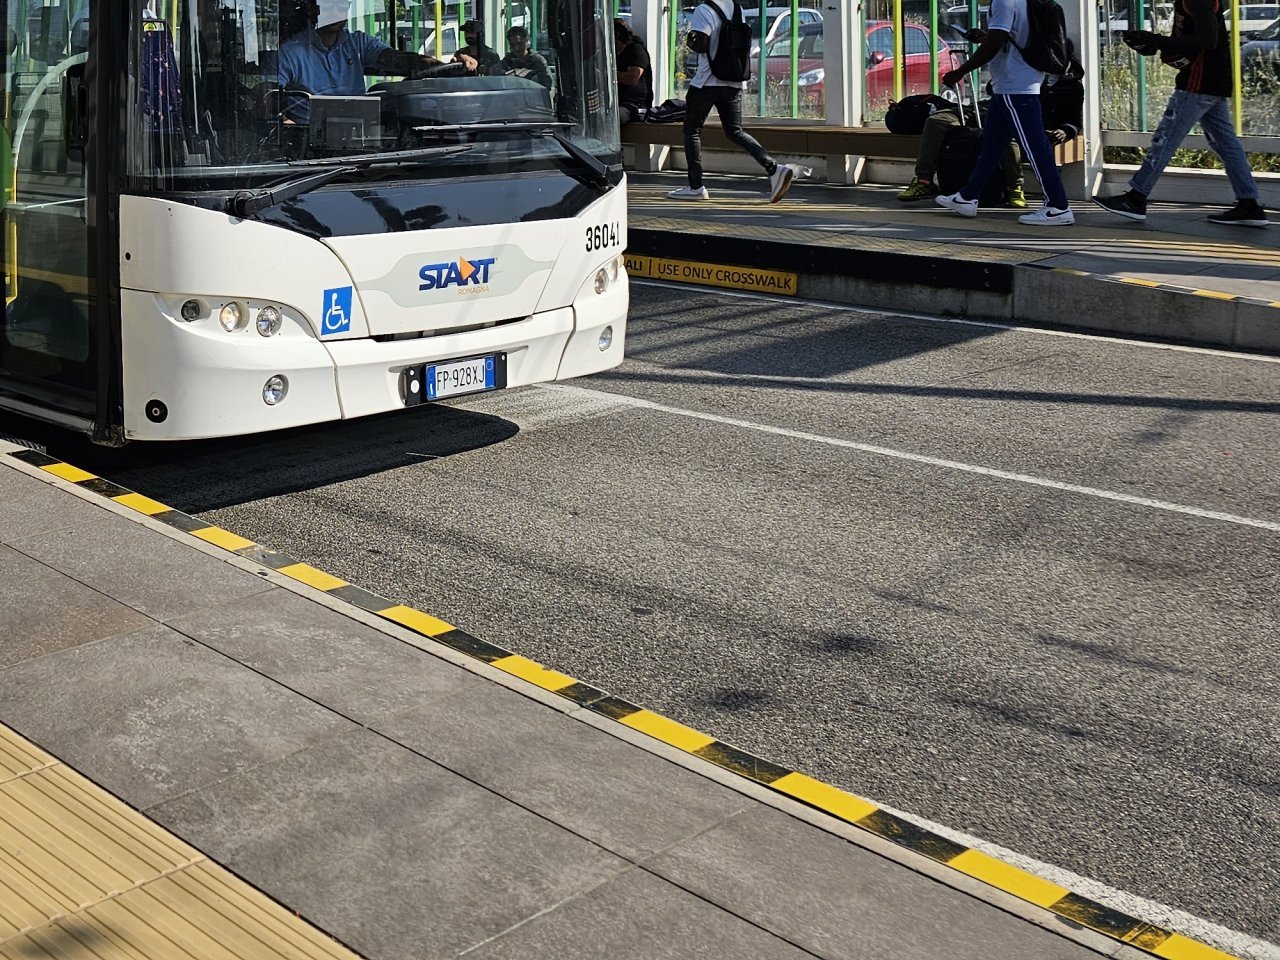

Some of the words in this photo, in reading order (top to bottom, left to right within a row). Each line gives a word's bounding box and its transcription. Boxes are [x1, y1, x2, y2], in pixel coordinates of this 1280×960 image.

[585, 220, 620, 253] 36041
[418, 256, 498, 292] START
[657, 262, 680, 276] USE
[682, 266, 714, 280] ONLY
[715, 270, 792, 290] CROSSWALK
[457, 285, 490, 296] ROMAGNA
